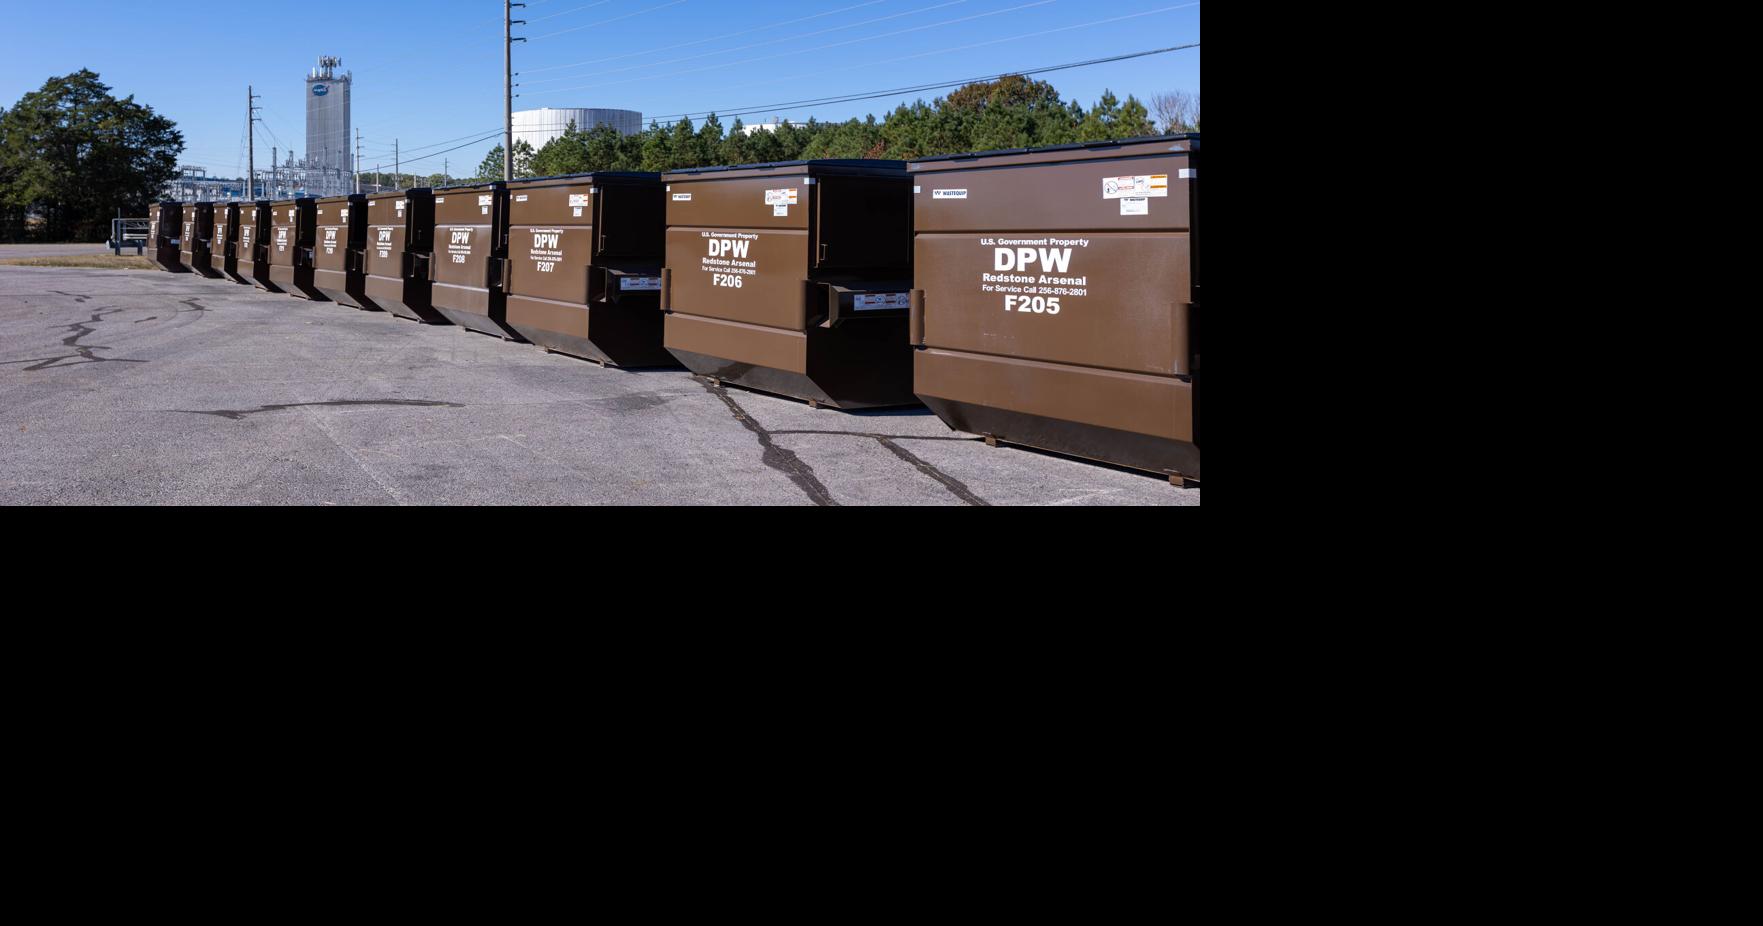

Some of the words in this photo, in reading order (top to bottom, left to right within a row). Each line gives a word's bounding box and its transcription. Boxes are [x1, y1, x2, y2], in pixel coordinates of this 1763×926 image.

[451, 231, 470, 244] DPW
[534, 233, 559, 249] DPW
[998, 238, 1048, 246] Government
[1050, 238, 1089, 248] Property
[708, 238, 750, 258] DPW
[702, 257, 730, 266] Redstone
[731, 259, 756, 268] Arsenal
[994, 247, 1072, 273] DPW
[536, 261, 555, 273] F207
[713, 273, 742, 288] F206
[982, 273, 1036, 284] Redstone
[1038, 274, 1086, 286] Arsenal
[982, 284, 994, 292] For
[995, 284, 1022, 293] Service
[1023, 286, 1037, 294] Call
[1038, 287, 1087, 296] 256-876-2801
[1004, 294, 1060, 315] F205
